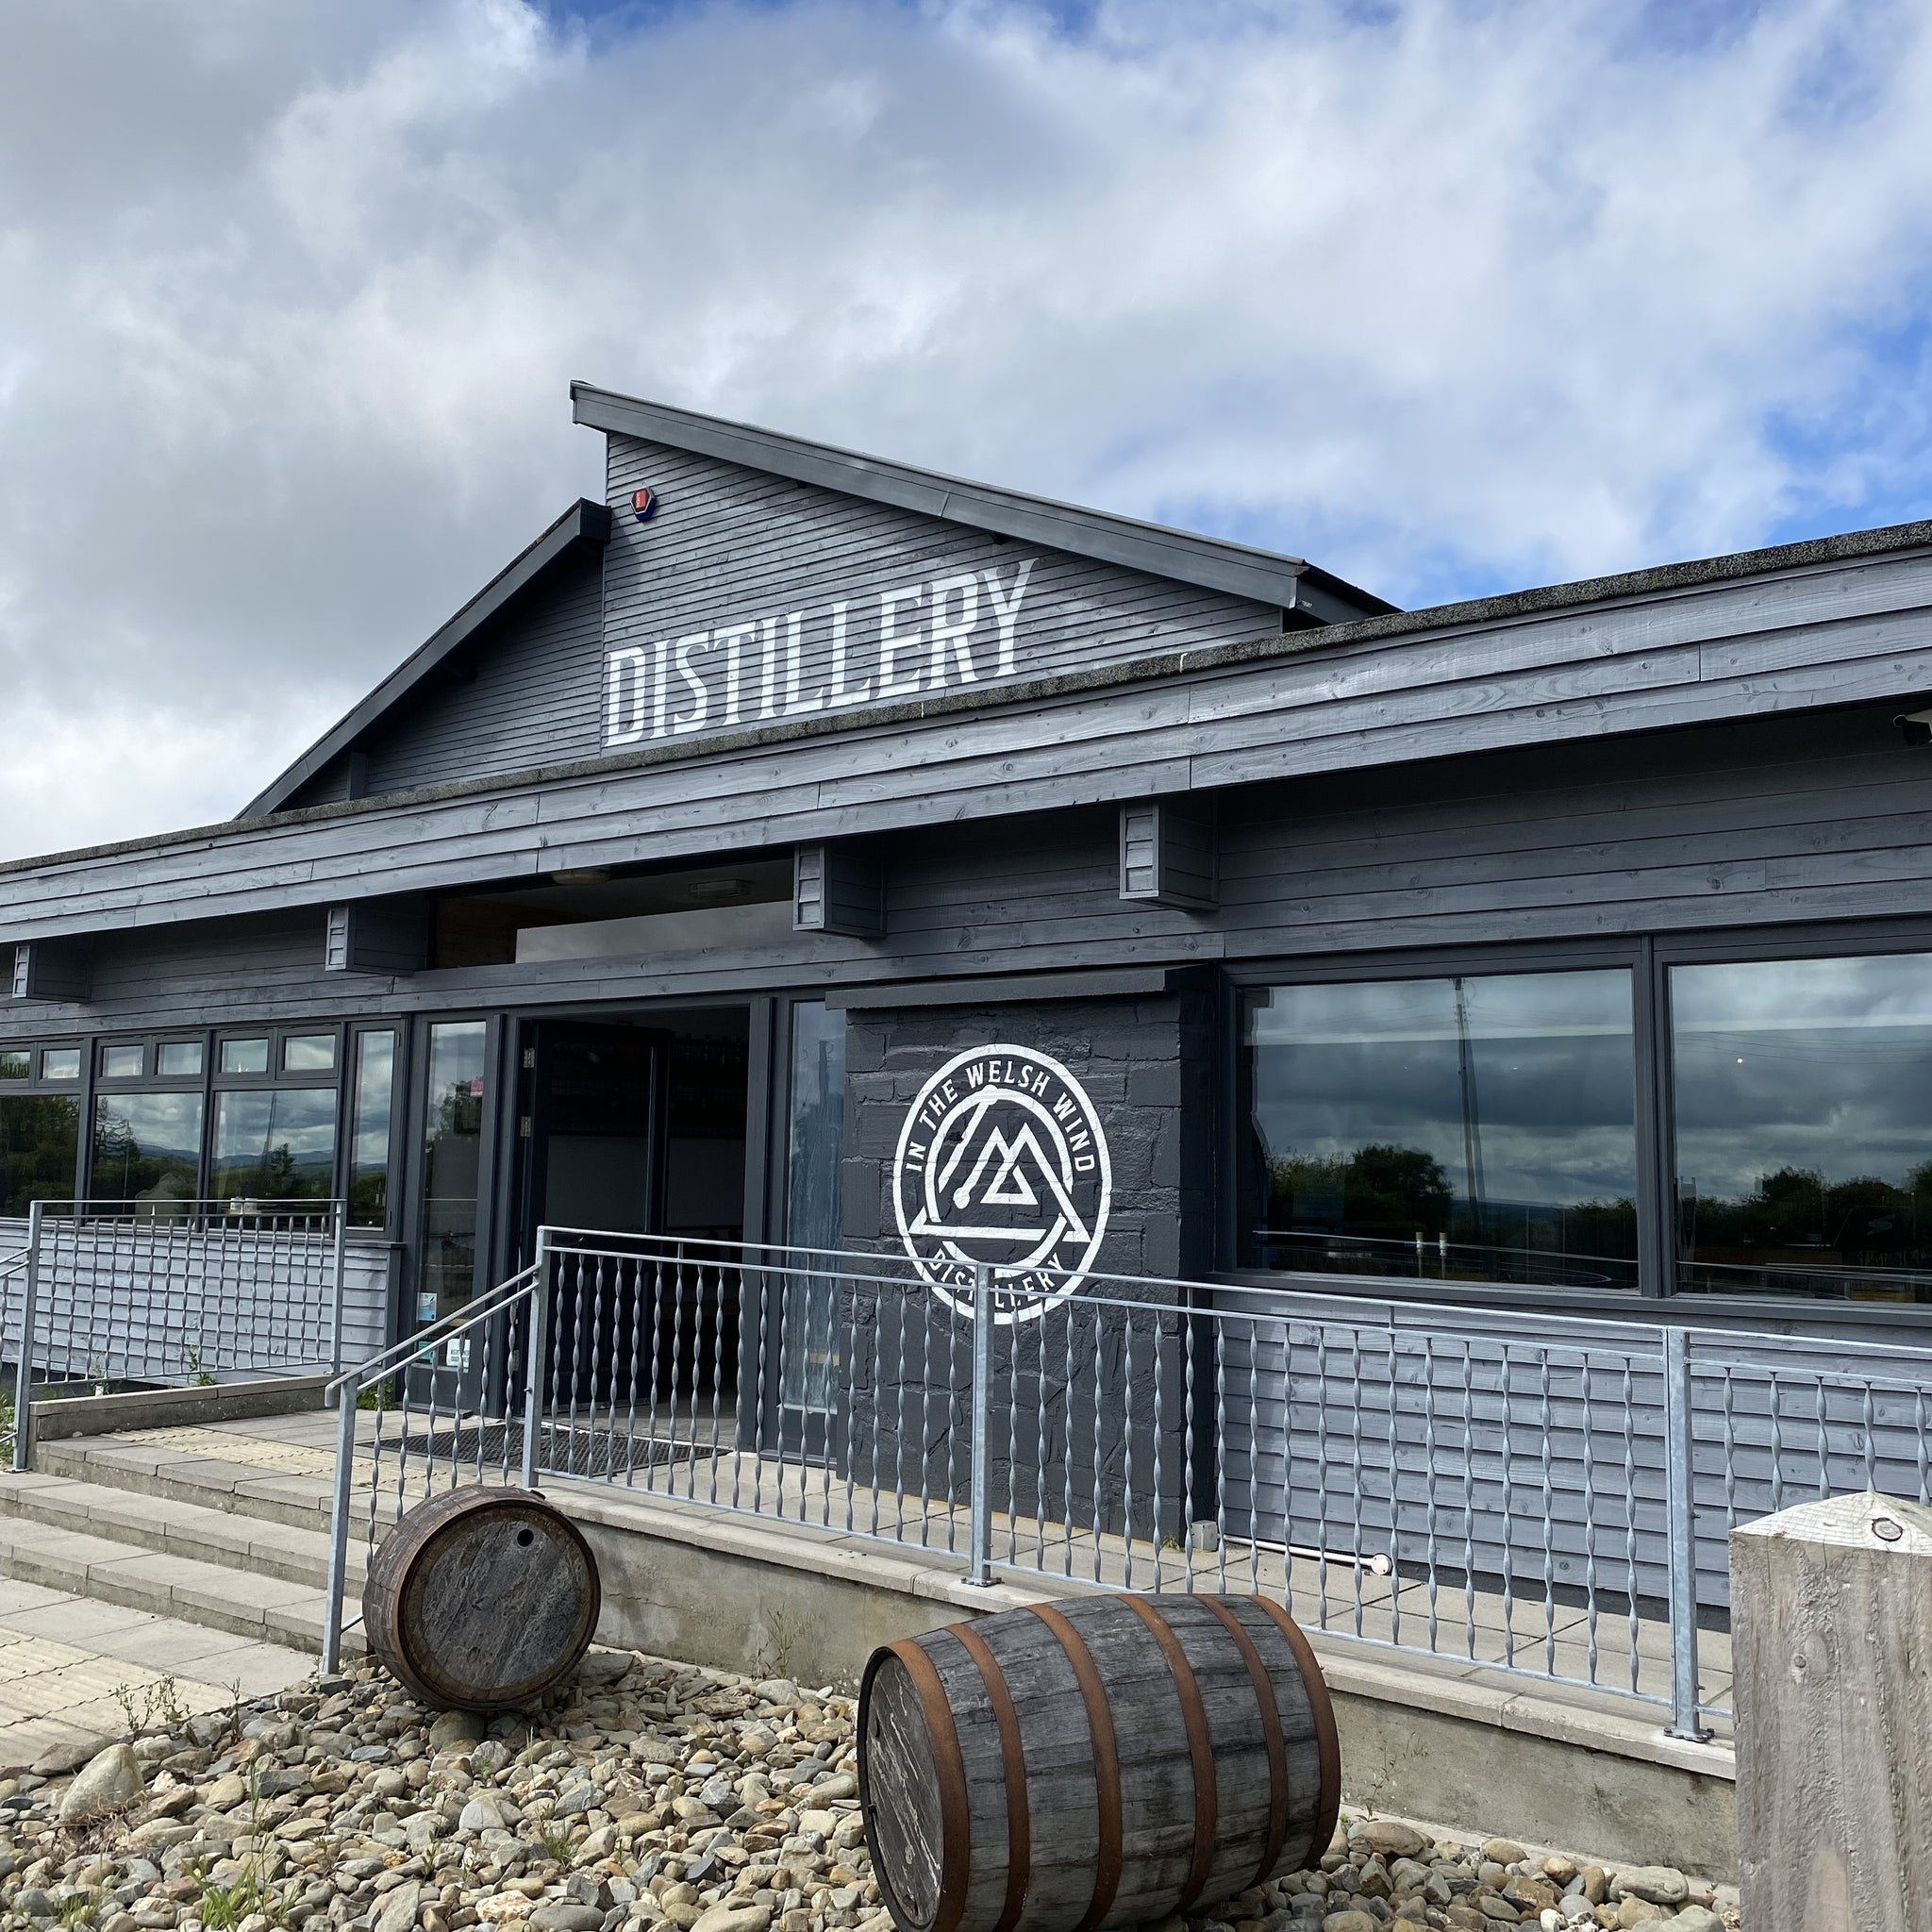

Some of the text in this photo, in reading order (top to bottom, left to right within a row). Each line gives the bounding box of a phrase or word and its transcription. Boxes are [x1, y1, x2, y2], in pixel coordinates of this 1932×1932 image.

[604, 558, 1040, 747] DISTILLERY
[905, 1059, 1095, 1172] IN THE WELSH WIND
[928, 1247, 1064, 1308] DISTLLERY
